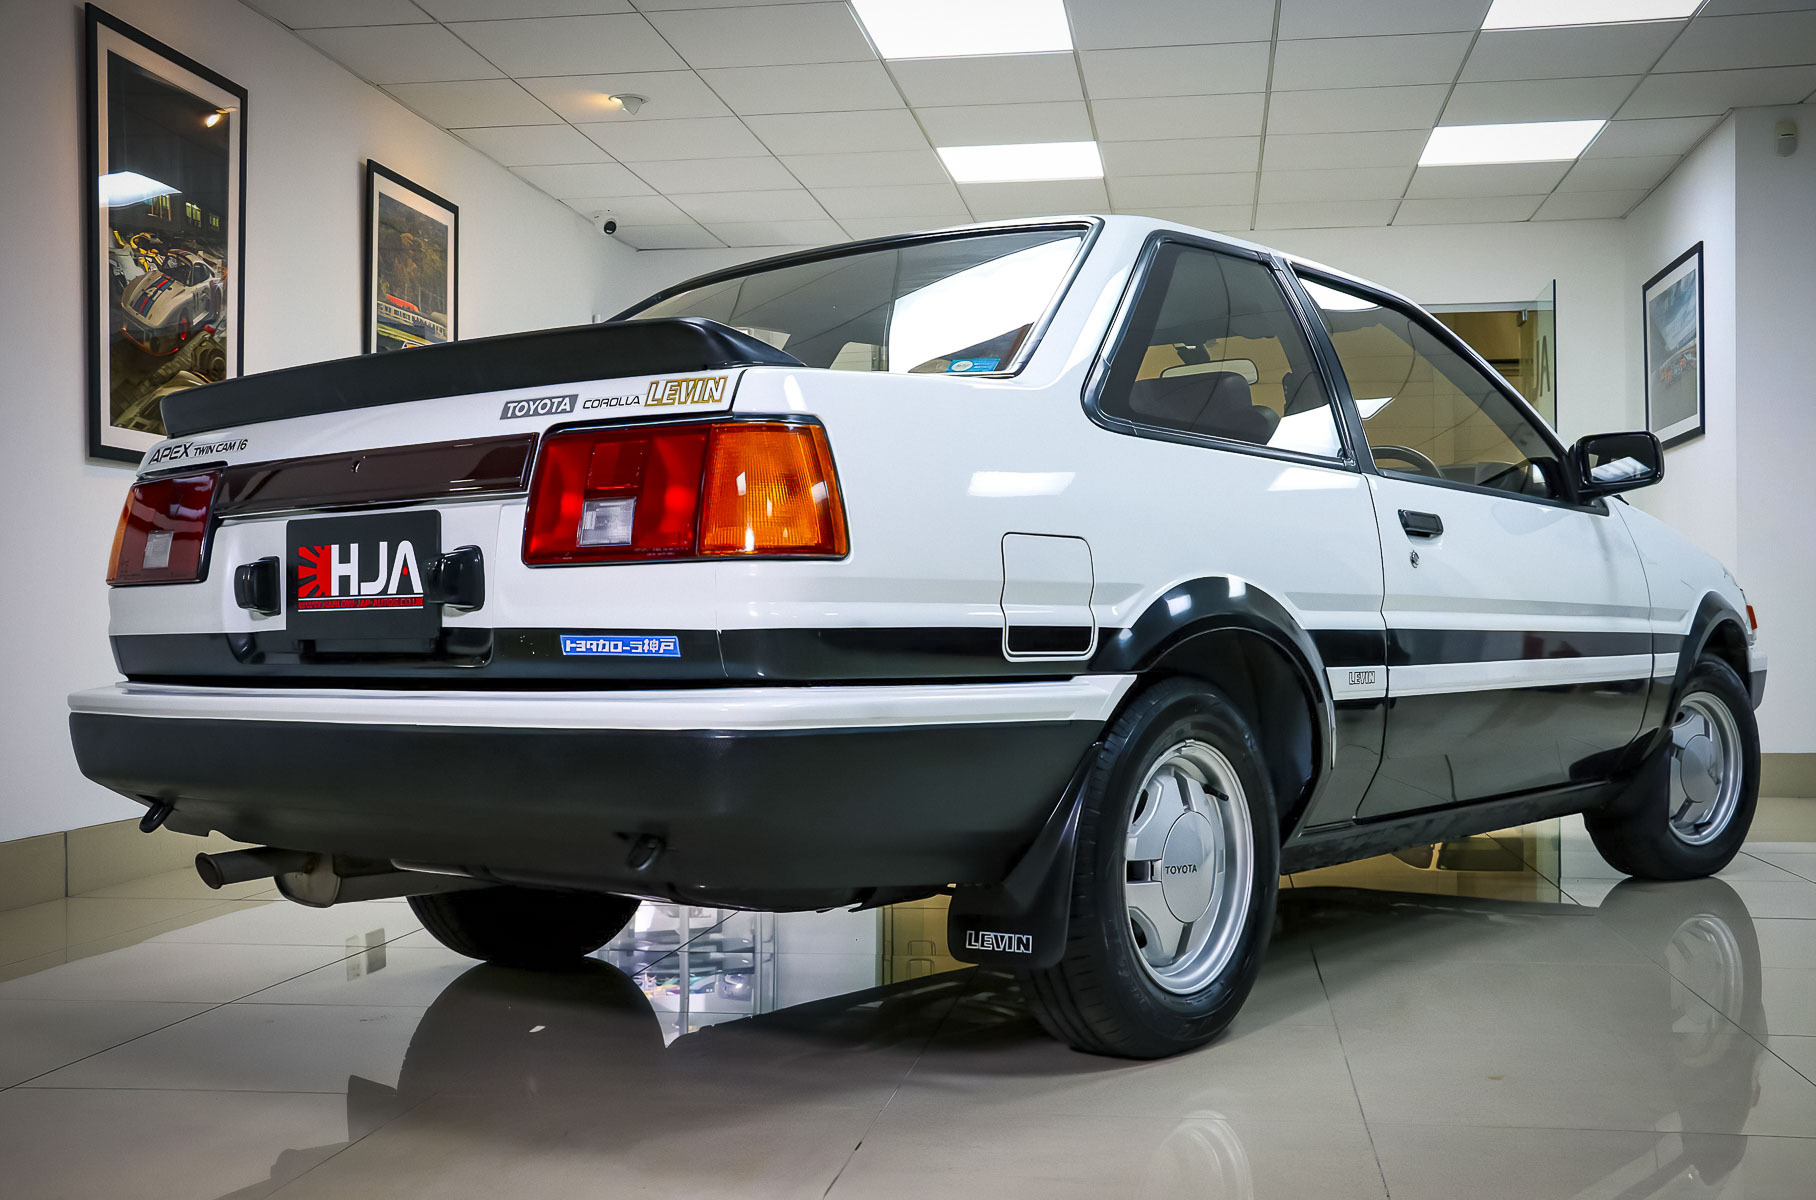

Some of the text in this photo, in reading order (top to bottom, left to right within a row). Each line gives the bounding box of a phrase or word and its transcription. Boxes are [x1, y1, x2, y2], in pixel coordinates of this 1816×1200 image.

[506, 375, 729, 418] TOYOTA COROLLA LEVIN
[148, 438, 249, 465] APEX TWIN CAM 16
[330, 540, 424, 597] HJA
[1348, 670, 1376, 686] LEVIN
[1164, 863, 1198, 875] TOYOTA
[965, 930, 1033, 954] LEVIN
